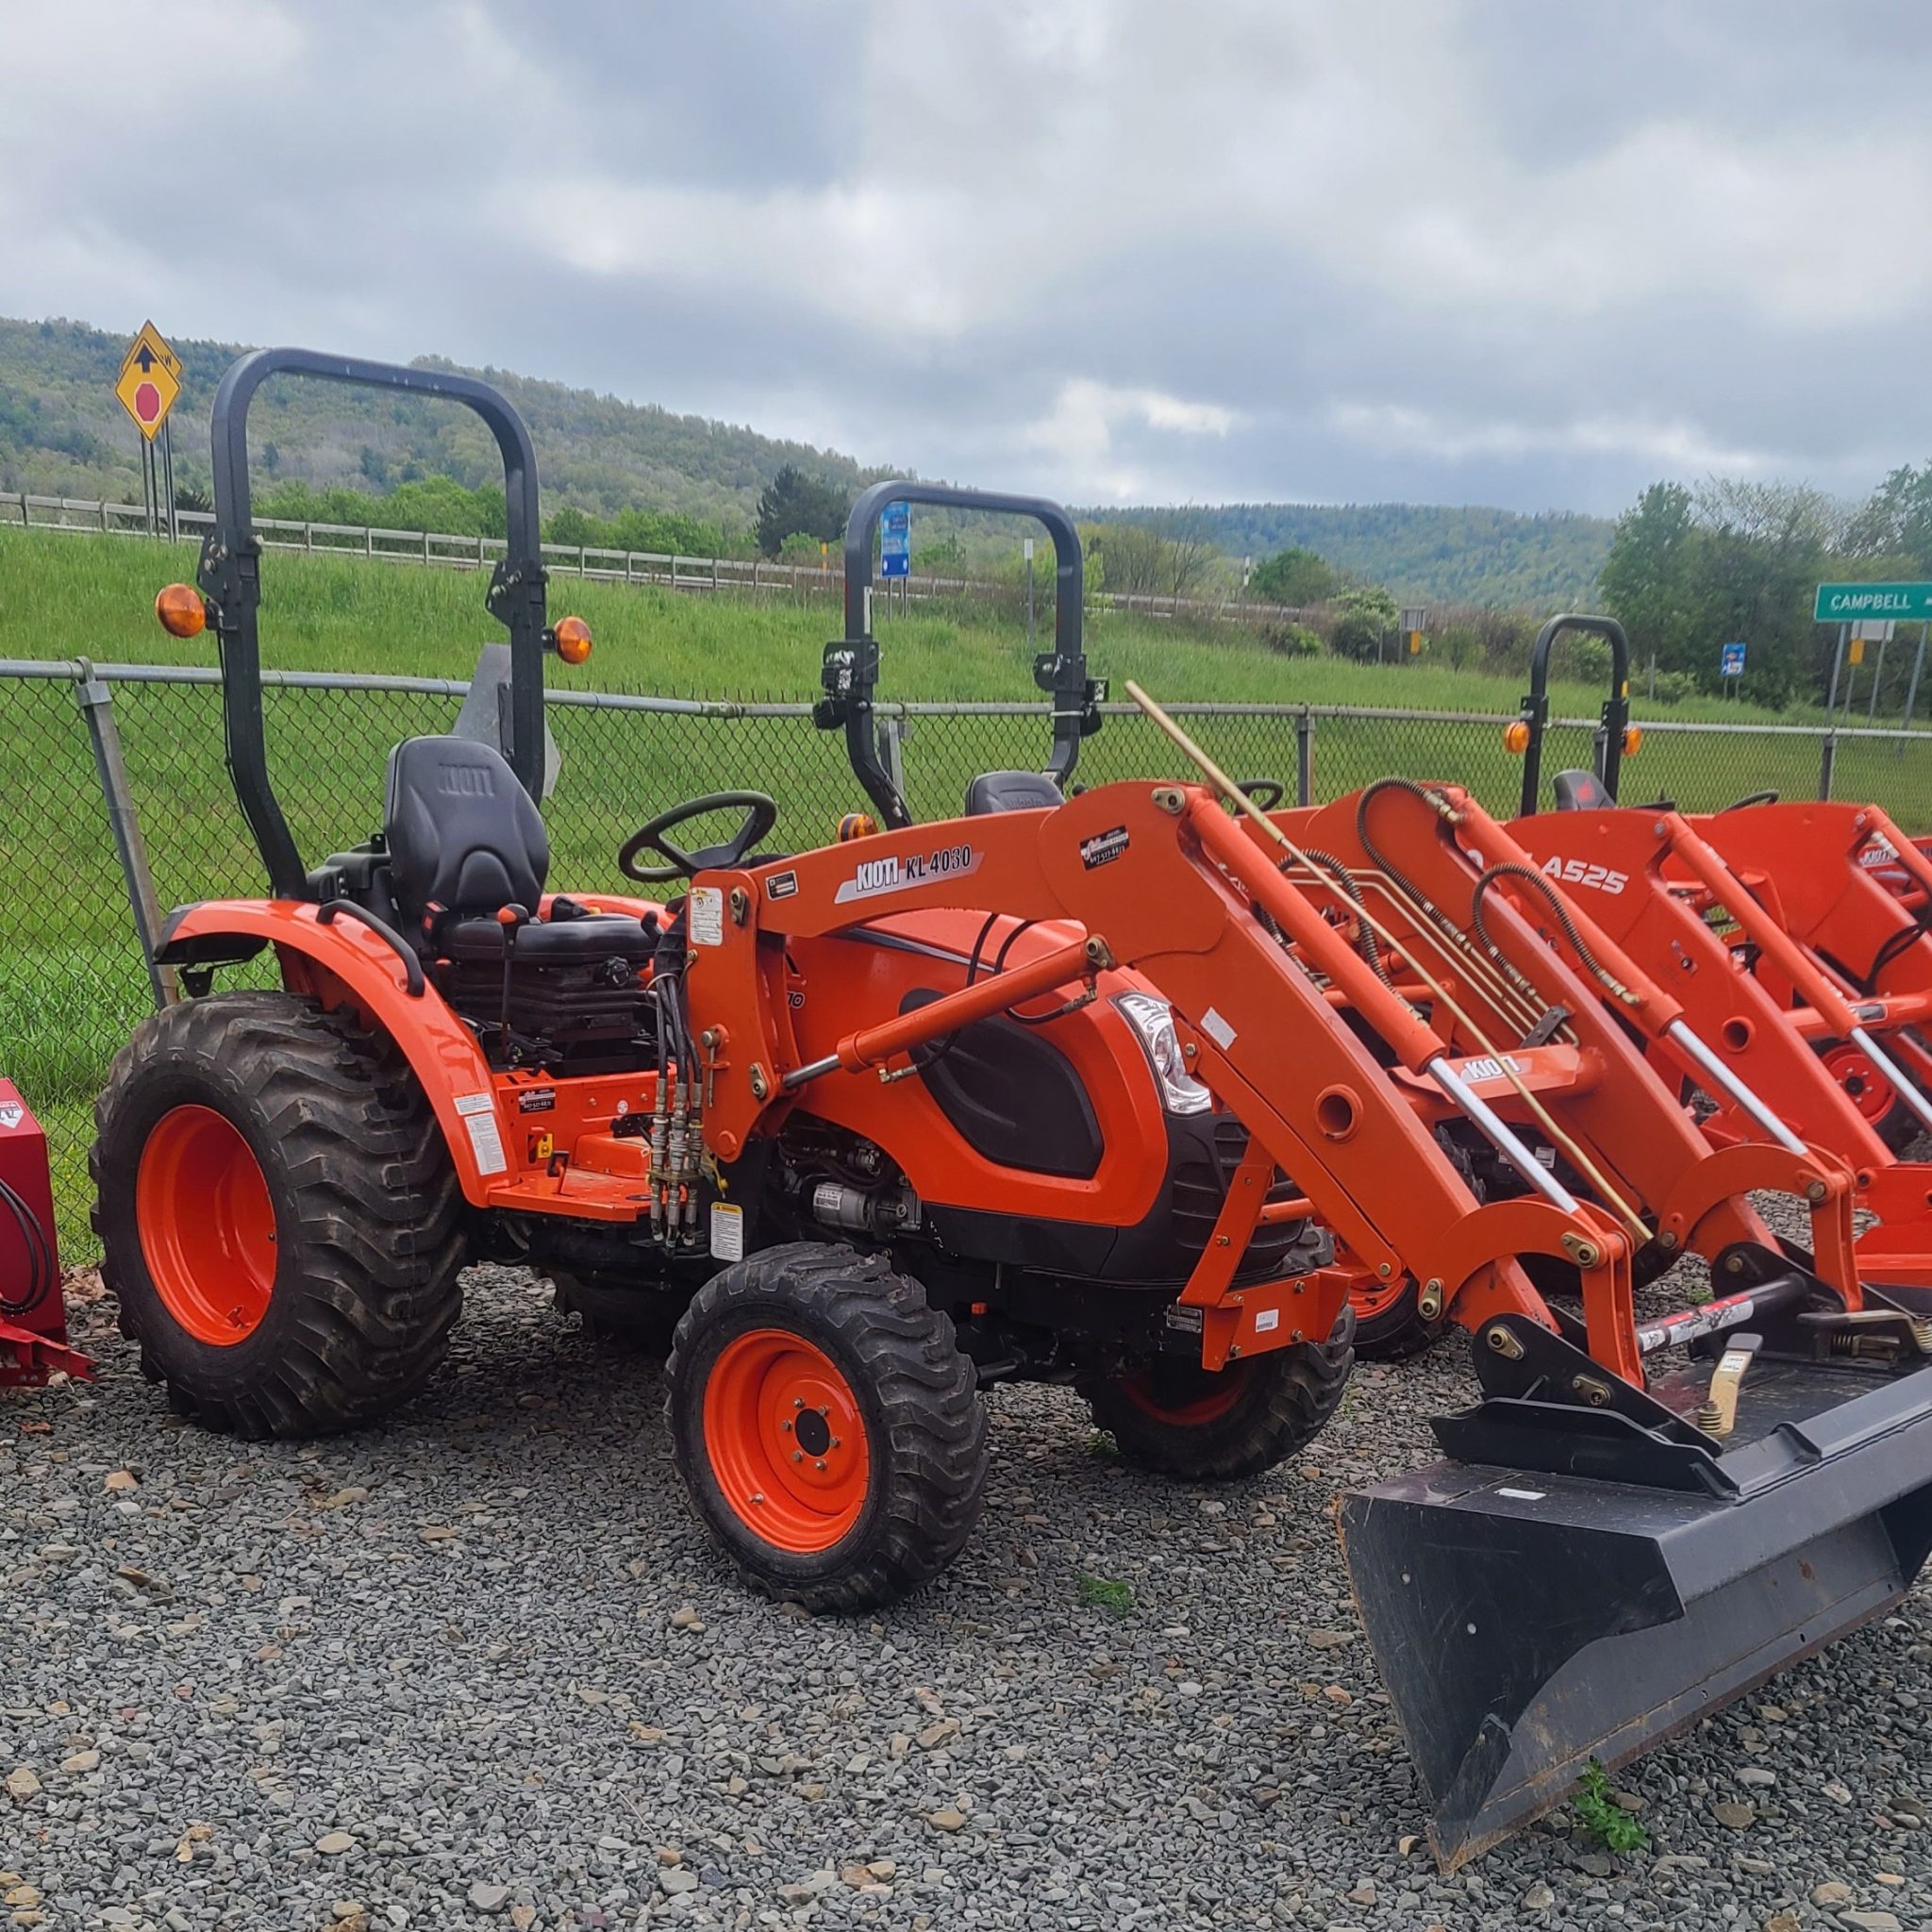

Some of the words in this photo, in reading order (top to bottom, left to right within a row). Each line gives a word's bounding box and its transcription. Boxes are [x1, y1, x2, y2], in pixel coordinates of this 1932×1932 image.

[1830, 593, 1912, 611] CAMPBELL
[857, 856, 899, 892] KIOTI
[906, 855, 926, 881] KL
[928, 844, 972, 876] 4030
[1524, 852, 1630, 895] A525
[1464, 1056, 1522, 1079] KIOI
